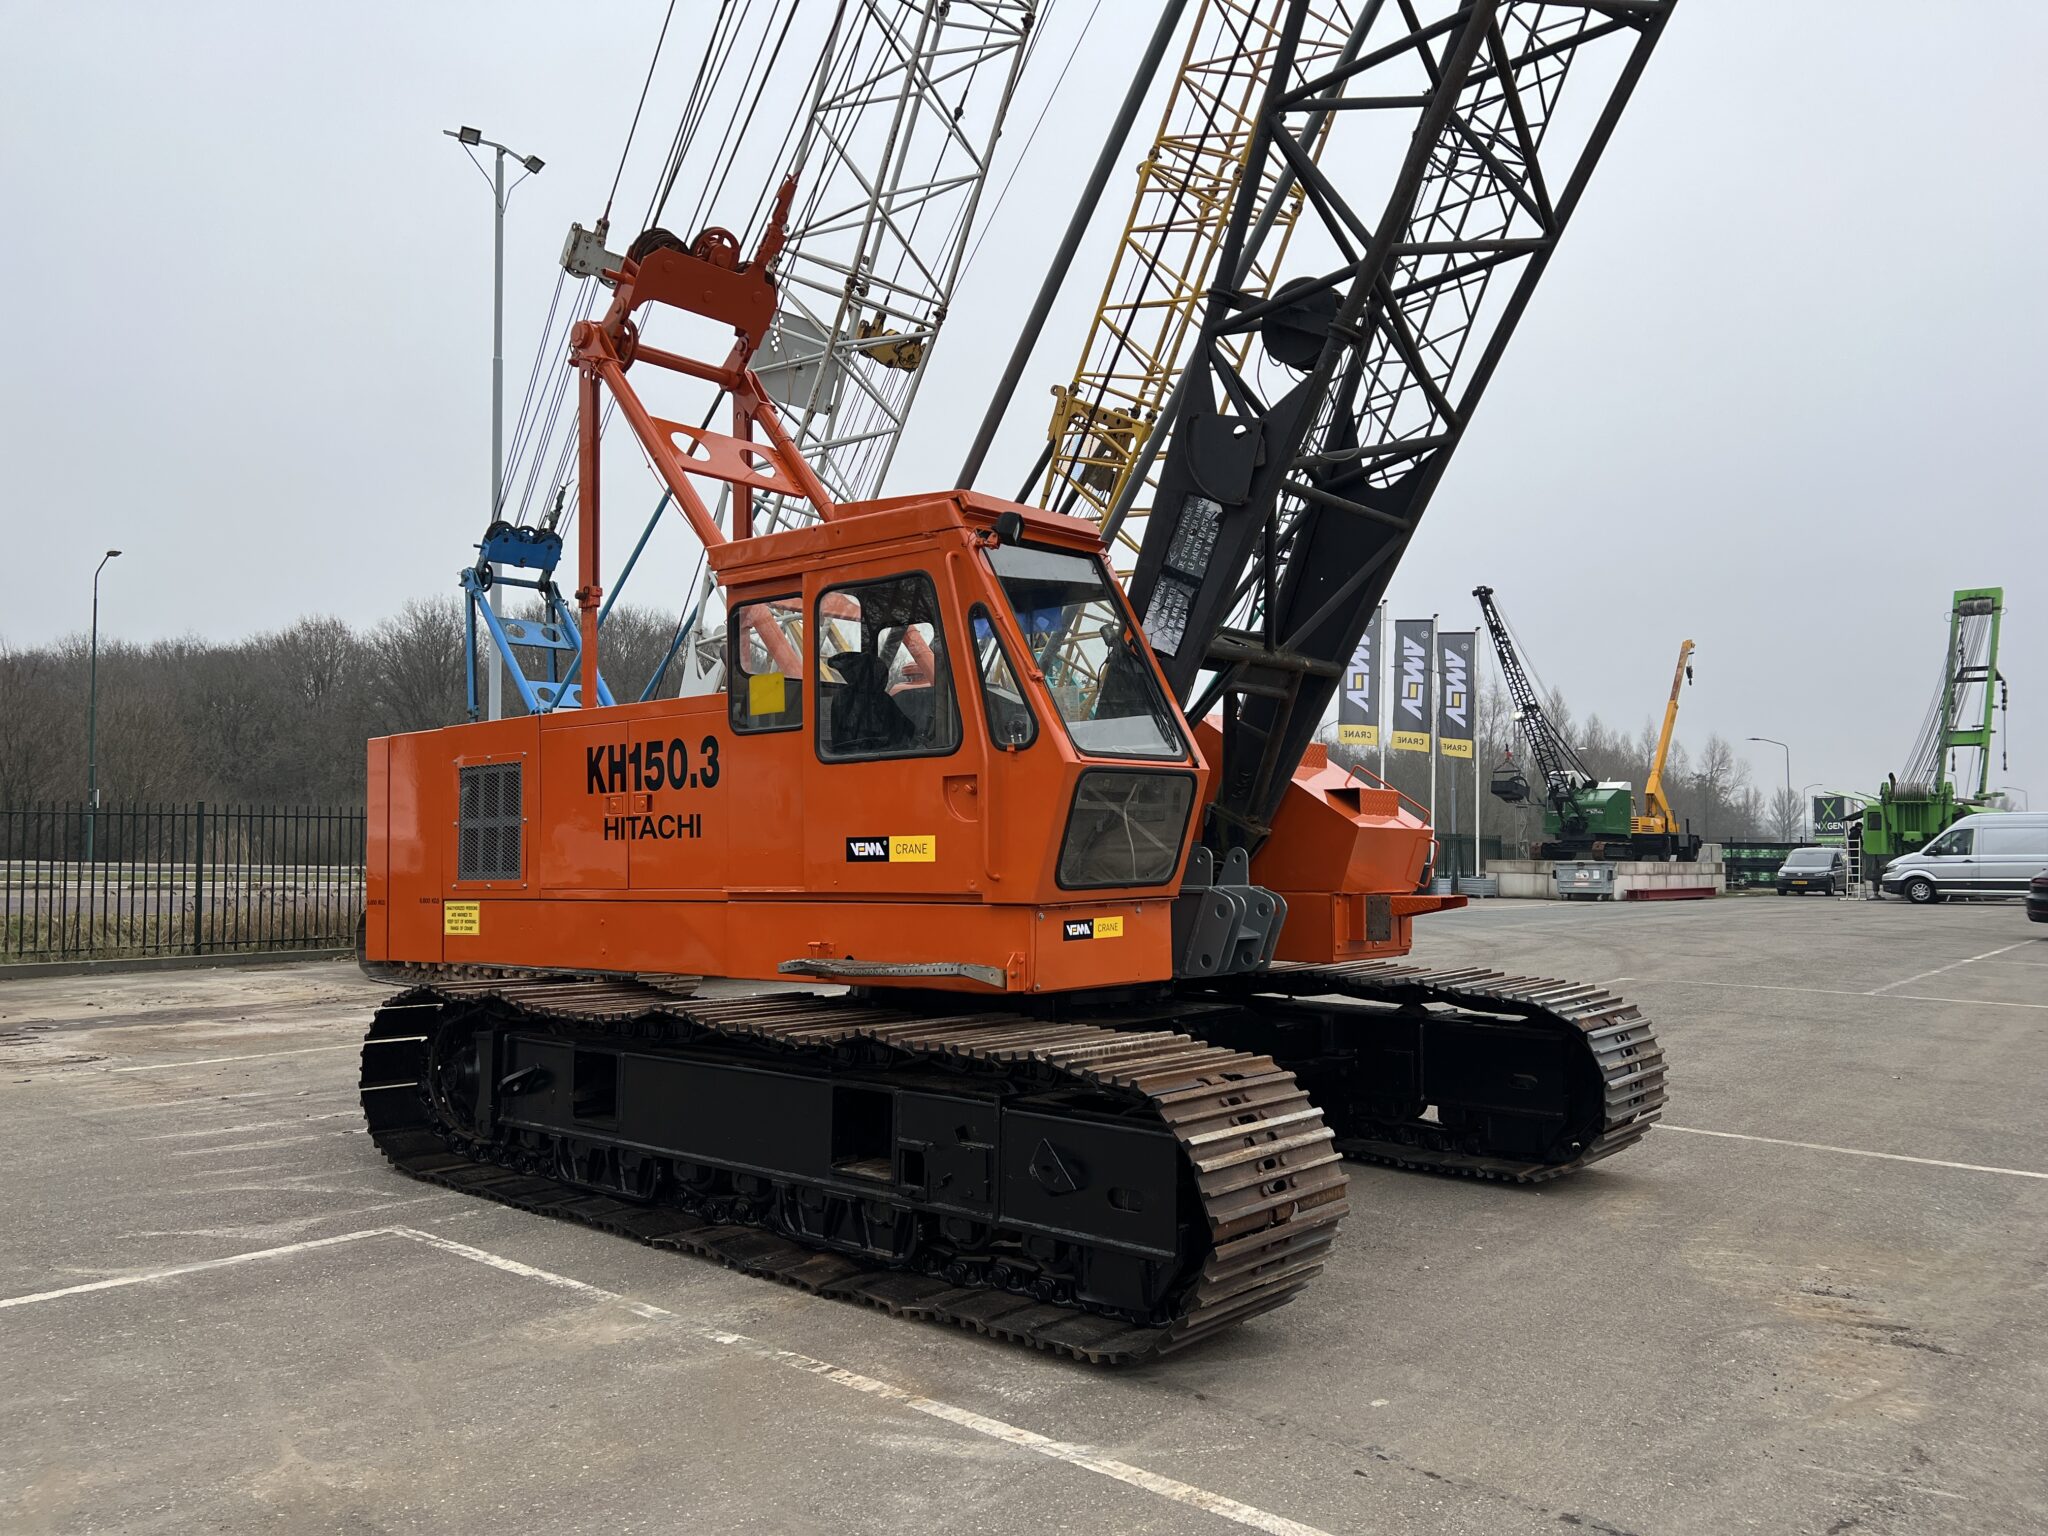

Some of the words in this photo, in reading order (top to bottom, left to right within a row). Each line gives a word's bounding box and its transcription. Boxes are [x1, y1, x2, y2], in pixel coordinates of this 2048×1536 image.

[1181, 519, 1199, 559] STATIONER
[587, 735, 720, 794] KH150.3
[604, 813, 702, 840] HITACHI
[1815, 820, 1844, 832] NXGEN
[850, 842, 885, 856] VEMA
[895, 843, 928, 855] CRANE
[1066, 923, 1091, 936] VEMA
[1097, 922, 1119, 933] CRANE
